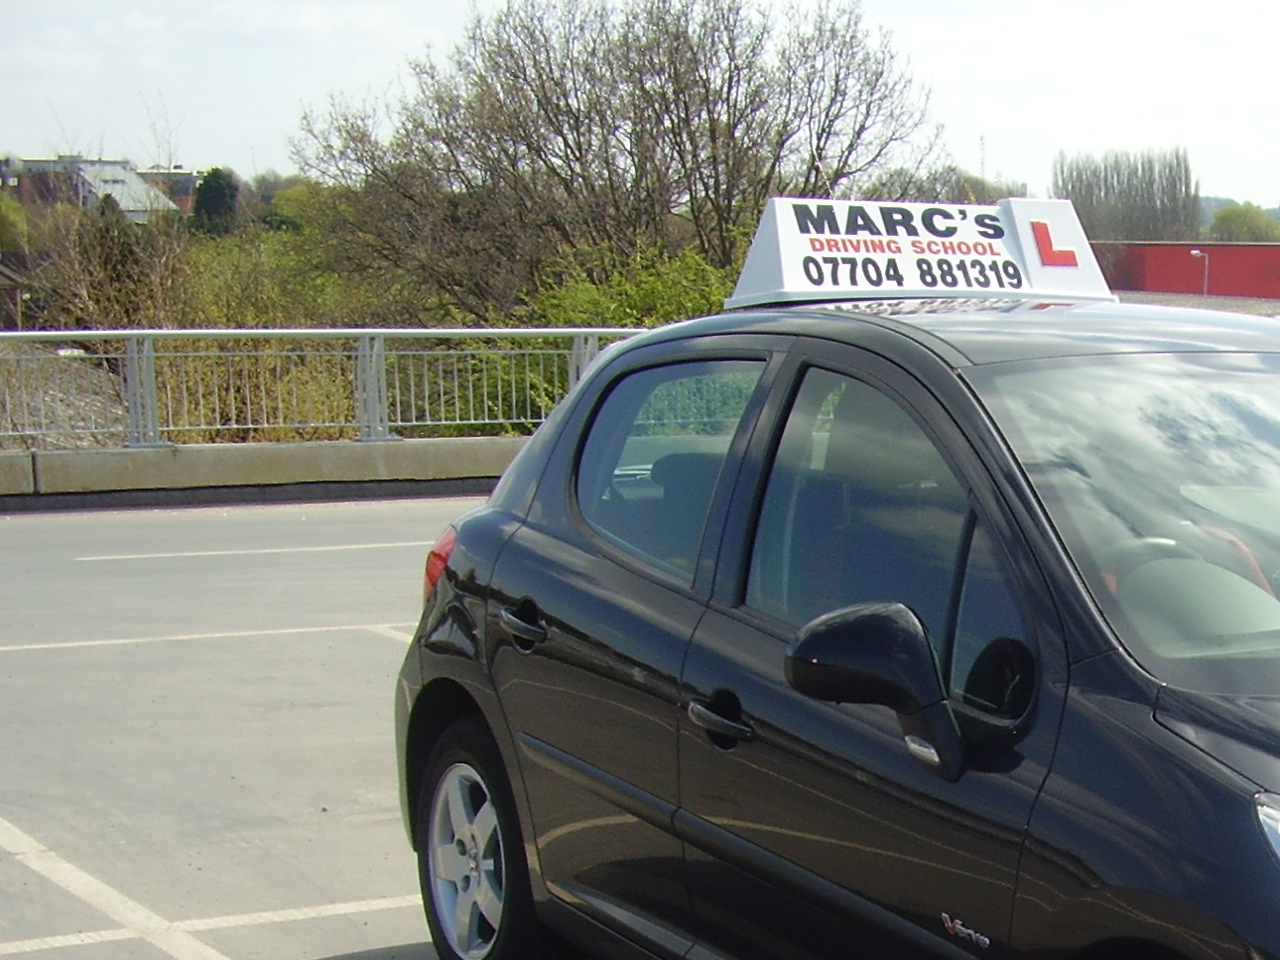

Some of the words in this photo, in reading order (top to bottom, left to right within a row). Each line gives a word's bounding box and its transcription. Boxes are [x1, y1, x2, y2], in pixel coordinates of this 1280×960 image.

[809, 238, 902, 254] DRIVING
[910, 240, 1001, 256] SCHOOL
[1030, 221, 1079, 267] L
[803, 256, 904, 287] 07704
[916, 258, 1022, 289] 881319
